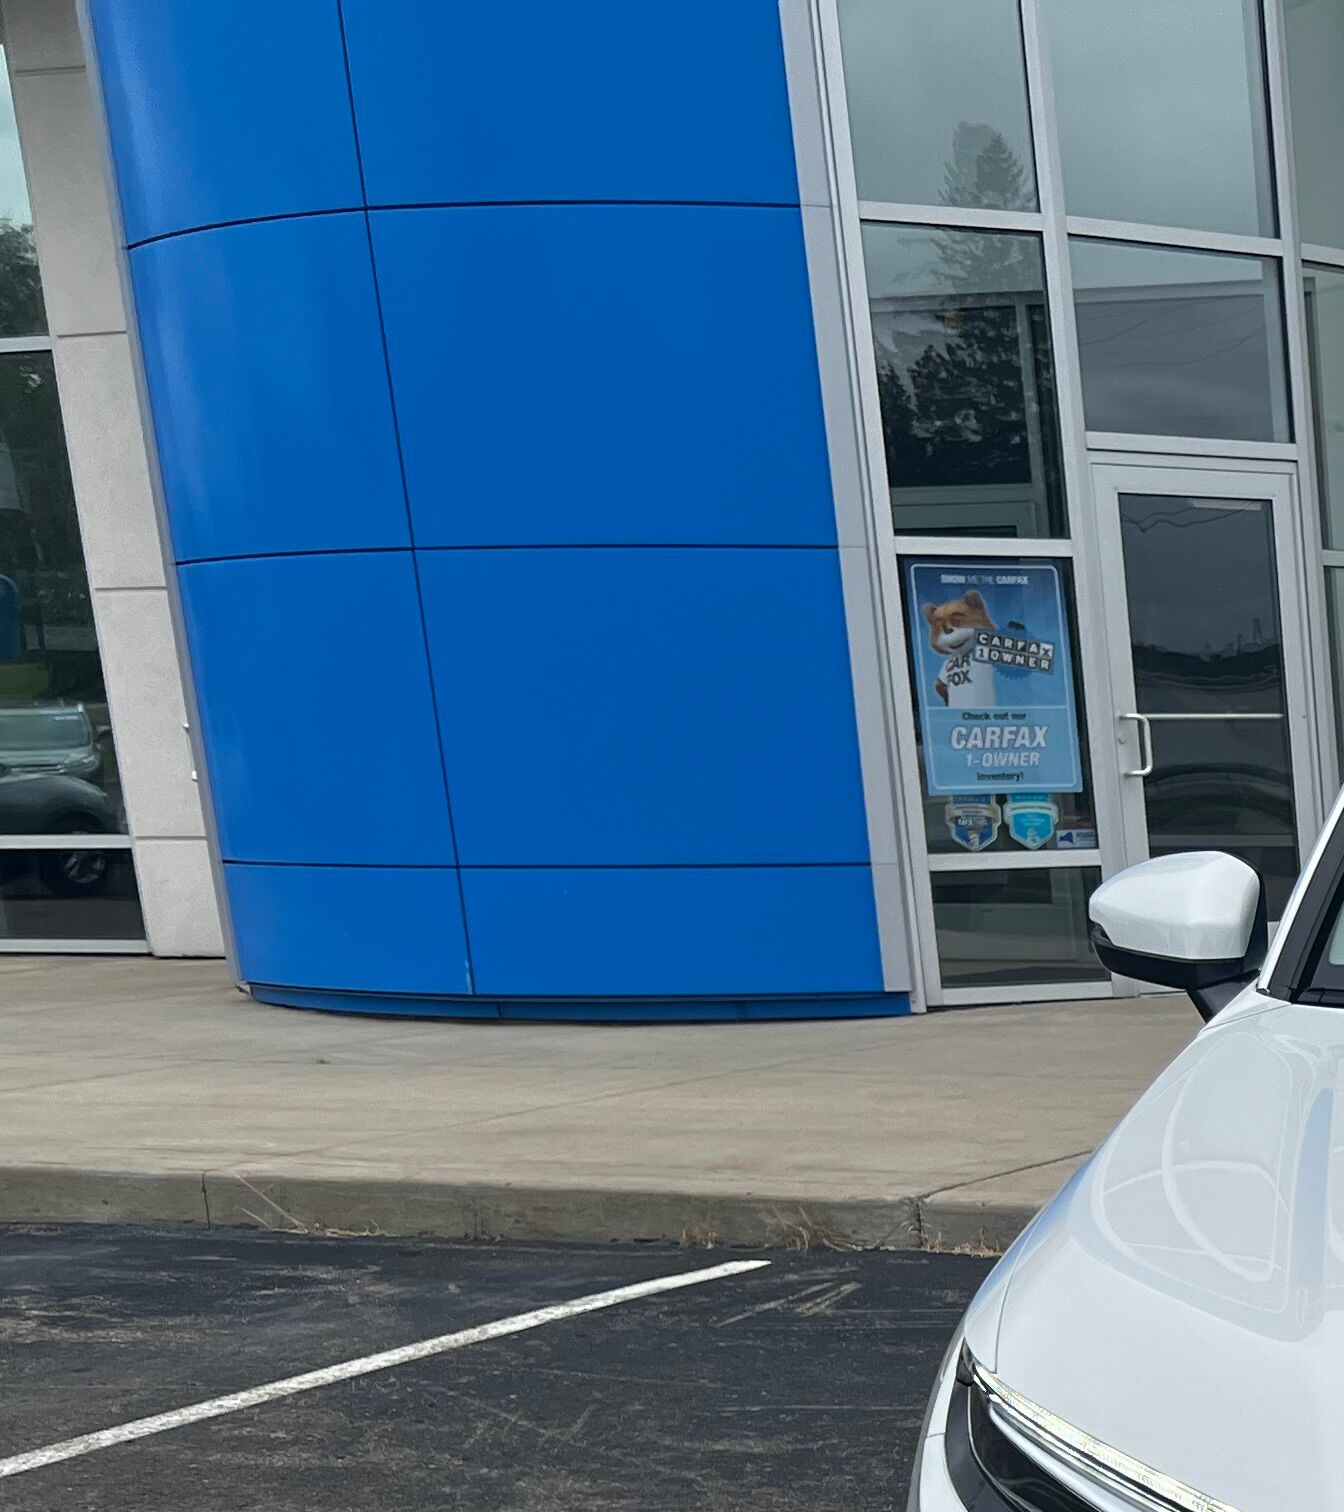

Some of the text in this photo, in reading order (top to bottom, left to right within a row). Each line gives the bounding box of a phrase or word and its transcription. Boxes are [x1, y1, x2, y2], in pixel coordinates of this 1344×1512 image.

[978, 633, 1052, 658] CARFAX
[990, 650, 1051, 671] OWNER
[951, 726, 1049, 750] CARFAX
[966, 751, 1040, 768] 1-OWNER
